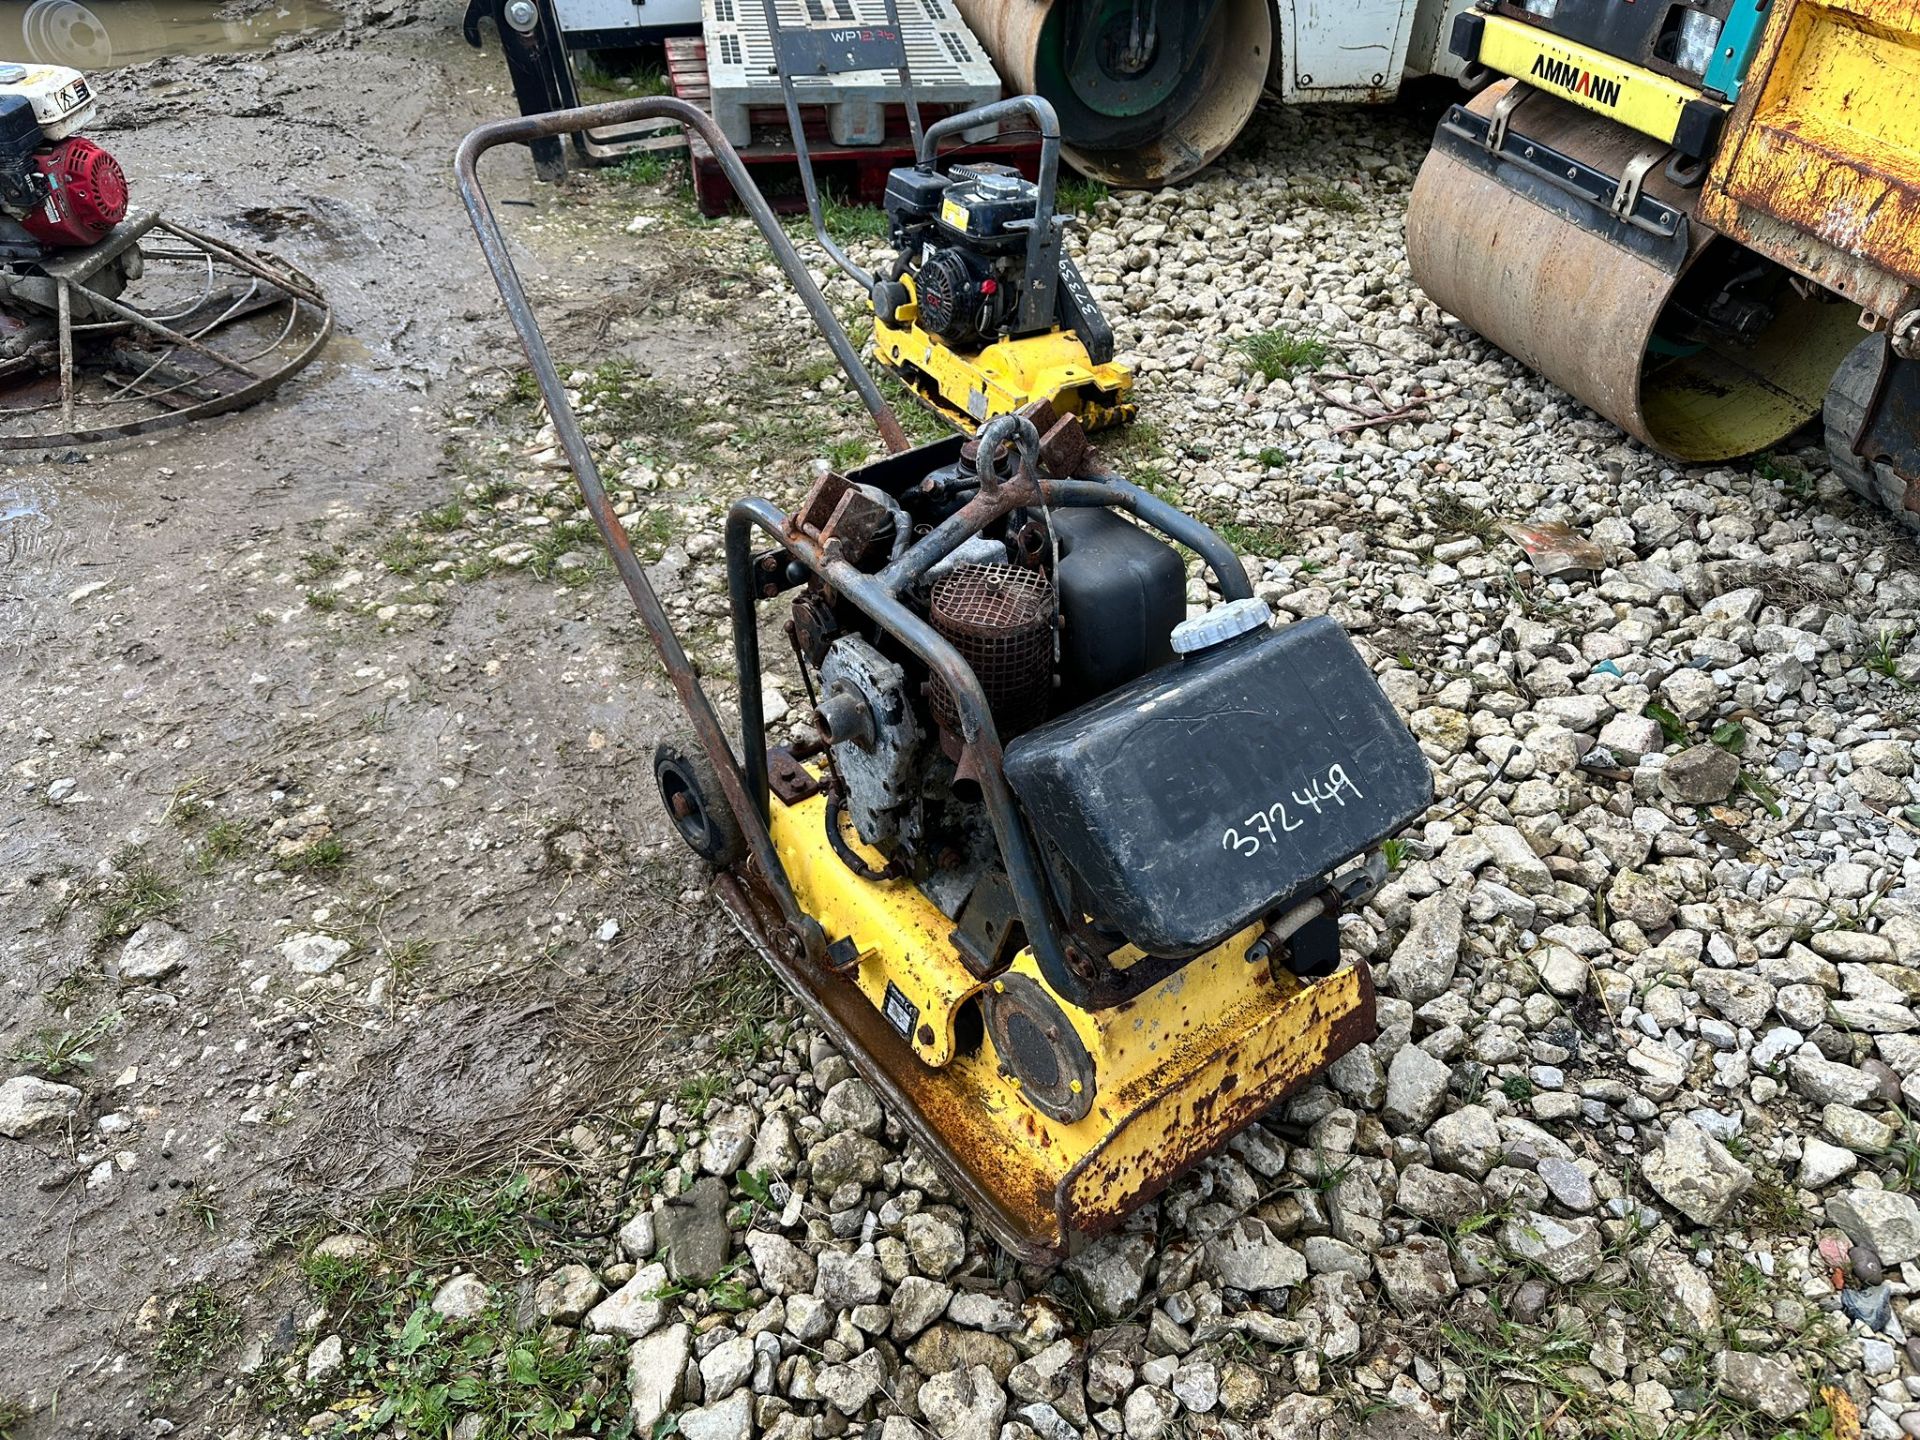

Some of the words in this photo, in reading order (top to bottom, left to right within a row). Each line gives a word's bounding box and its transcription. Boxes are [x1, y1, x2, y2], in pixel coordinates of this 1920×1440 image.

[1531, 54, 1621, 107] AMMANN
[1058, 243, 1098, 315] 37339
[1223, 763, 1364, 858] 372449
